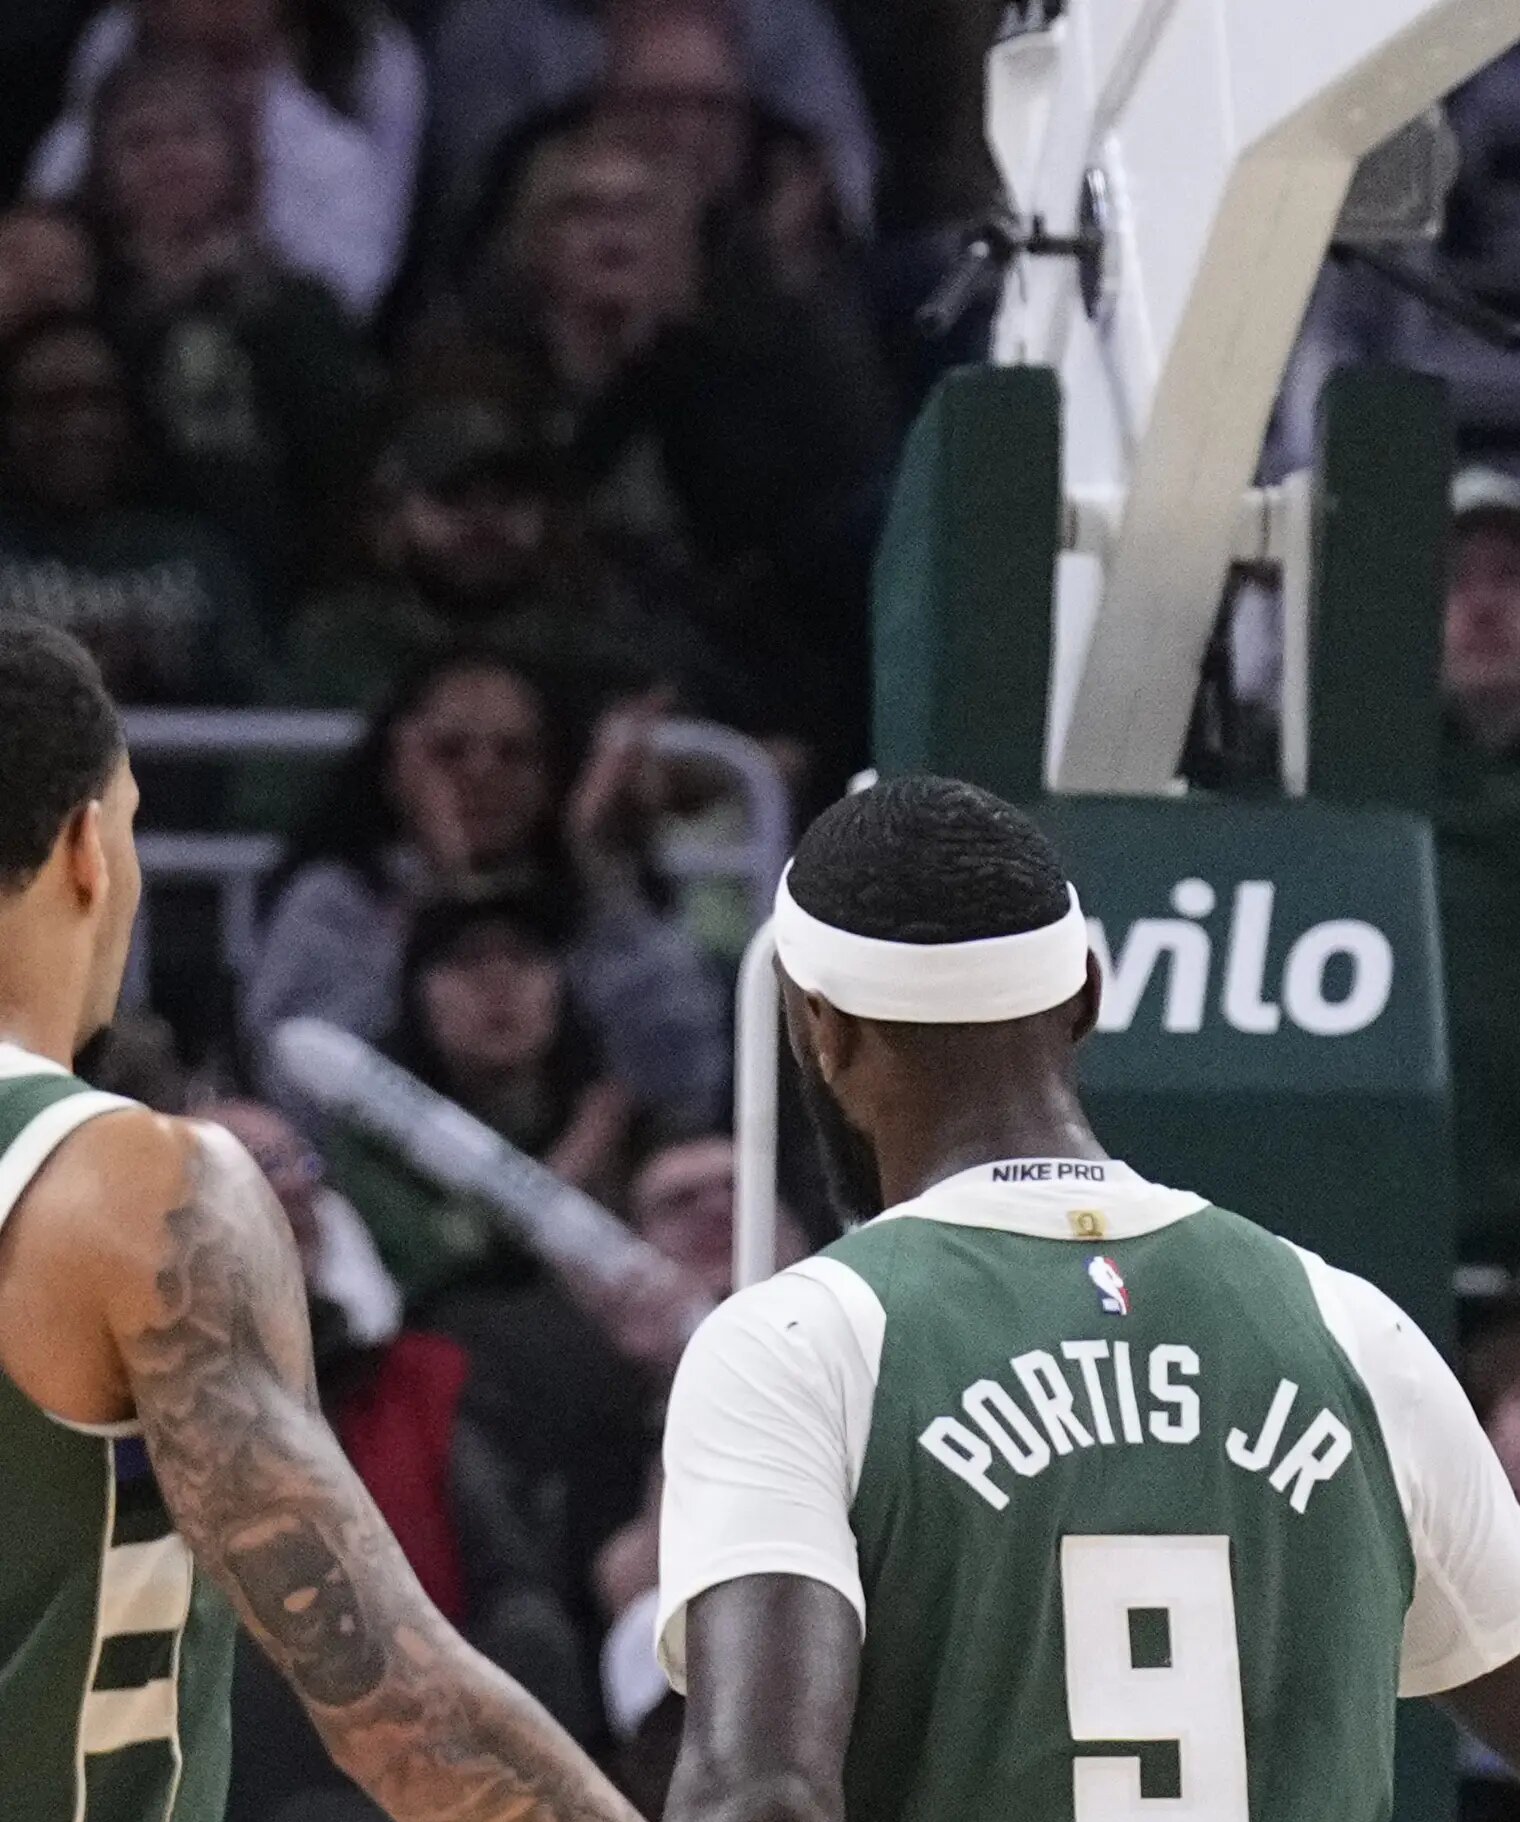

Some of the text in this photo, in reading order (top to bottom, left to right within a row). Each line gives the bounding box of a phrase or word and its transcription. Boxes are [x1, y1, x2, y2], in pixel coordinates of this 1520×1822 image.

[992, 1163, 1105, 1182] NIKE PRO
[917, 1339, 1353, 1514] PORTIS JR
